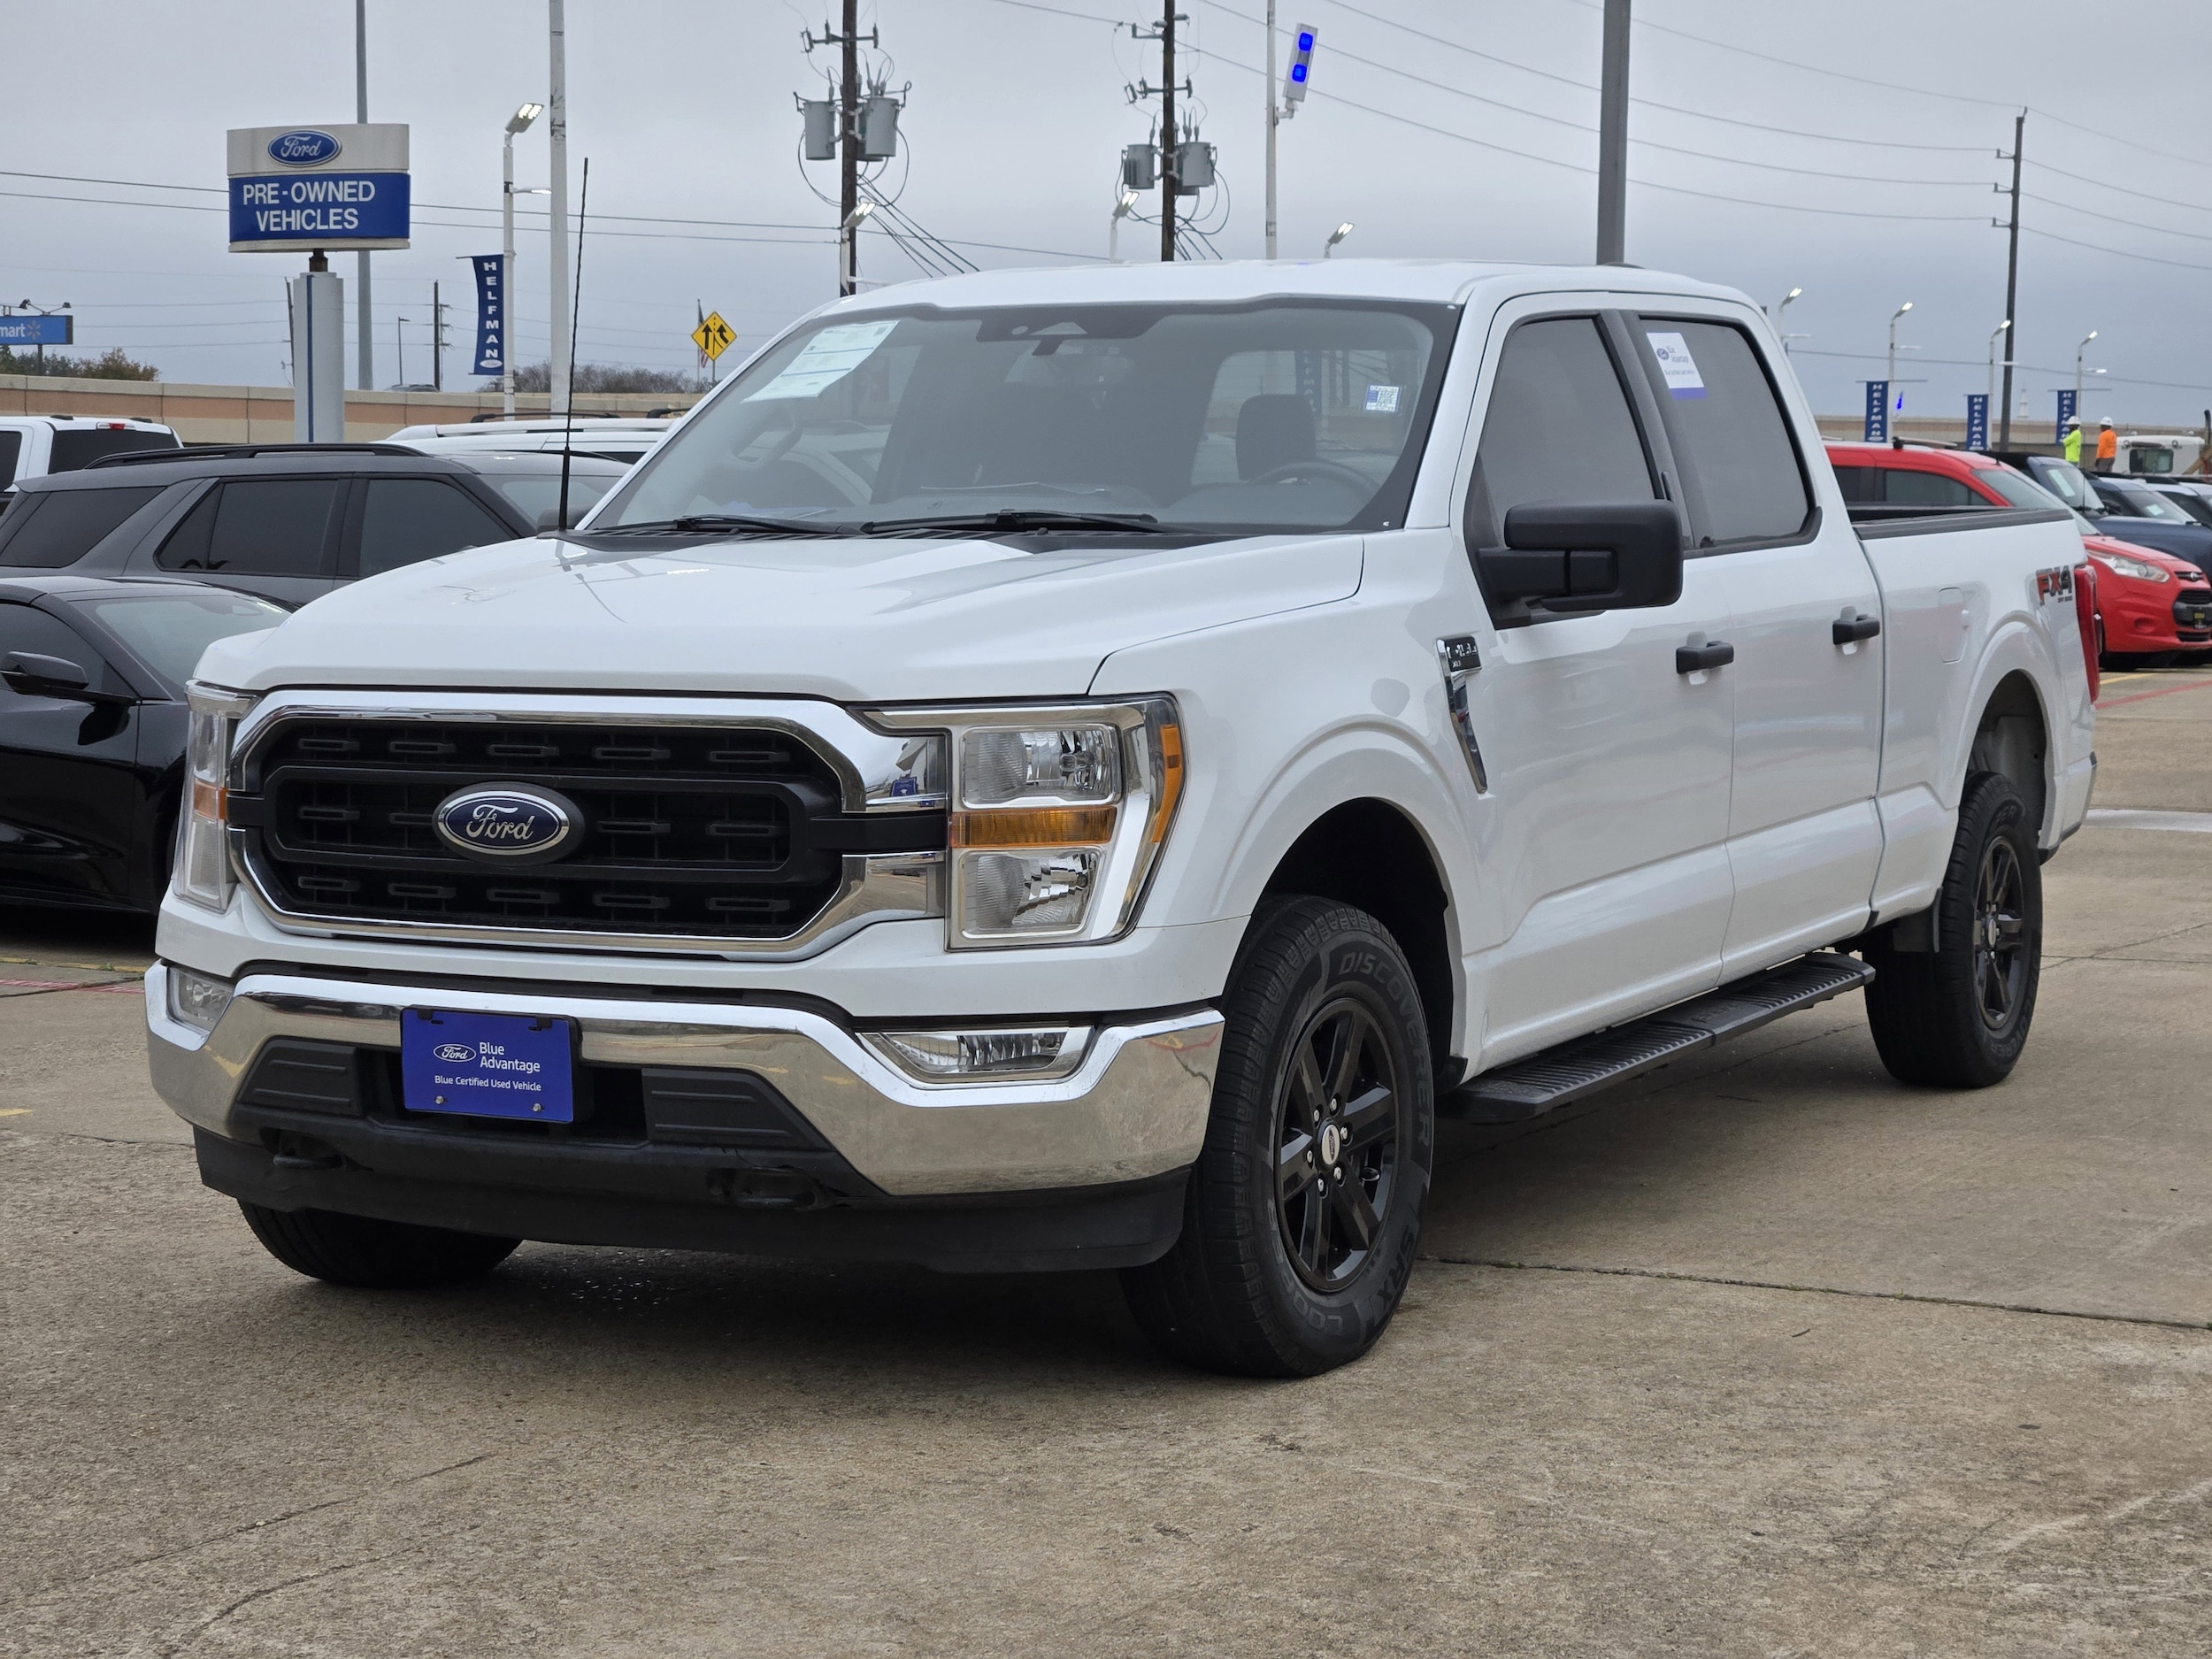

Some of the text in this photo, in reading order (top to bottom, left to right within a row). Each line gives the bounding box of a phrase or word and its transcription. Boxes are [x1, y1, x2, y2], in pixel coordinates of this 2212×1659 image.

[280, 135, 322, 157] Ford
[243, 180, 376, 205] PRE-OWNED
[256, 208, 359, 232] VEHICLES
[483, 262, 499, 358] HELFMAN
[1871, 384, 1882, 435] HELFMAN
[2036, 565, 2072, 606] FX4
[466, 804, 535, 840] Ford
[442, 1045, 468, 1060] Ford
[479, 1042, 504, 1056] Blue
[1337, 950, 1433, 1148] DISCOVERER
[480, 1056, 541, 1073] Advantage
[434, 1075, 541, 1091] Blue Certified Used Vehicle
